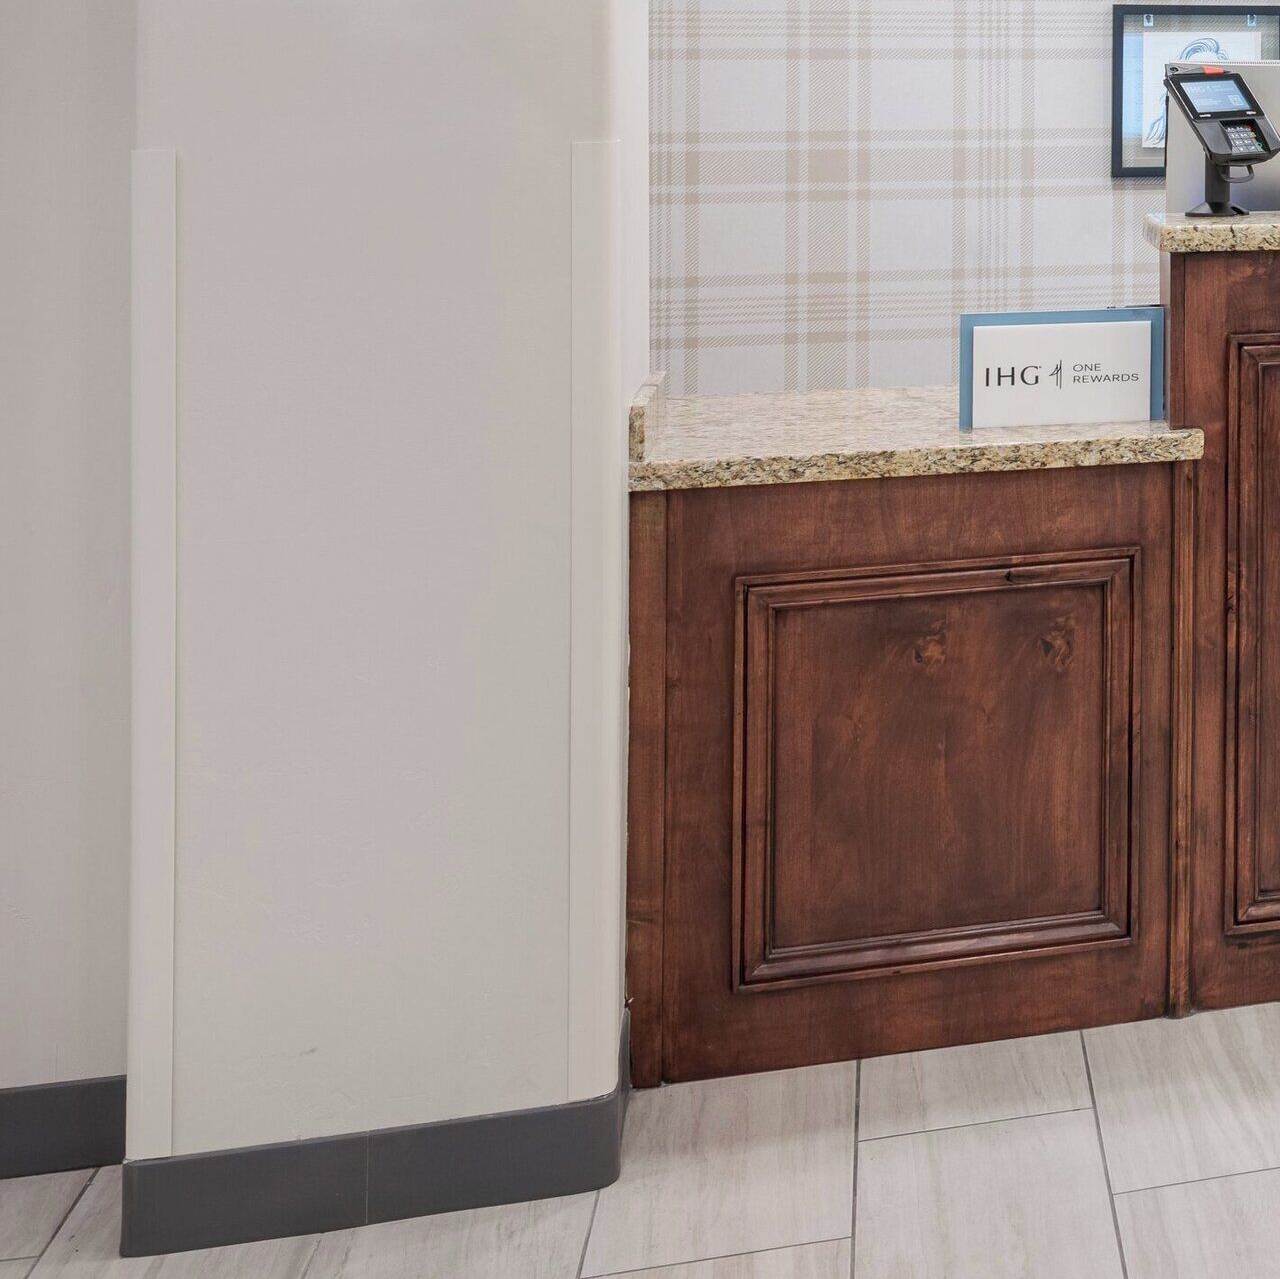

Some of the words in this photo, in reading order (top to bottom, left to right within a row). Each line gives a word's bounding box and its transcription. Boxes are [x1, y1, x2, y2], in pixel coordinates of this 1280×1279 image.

[1072, 363, 1101, 372] ONE
[985, 365, 1040, 387] IHG
[1073, 372, 1140, 384] REWARDS
